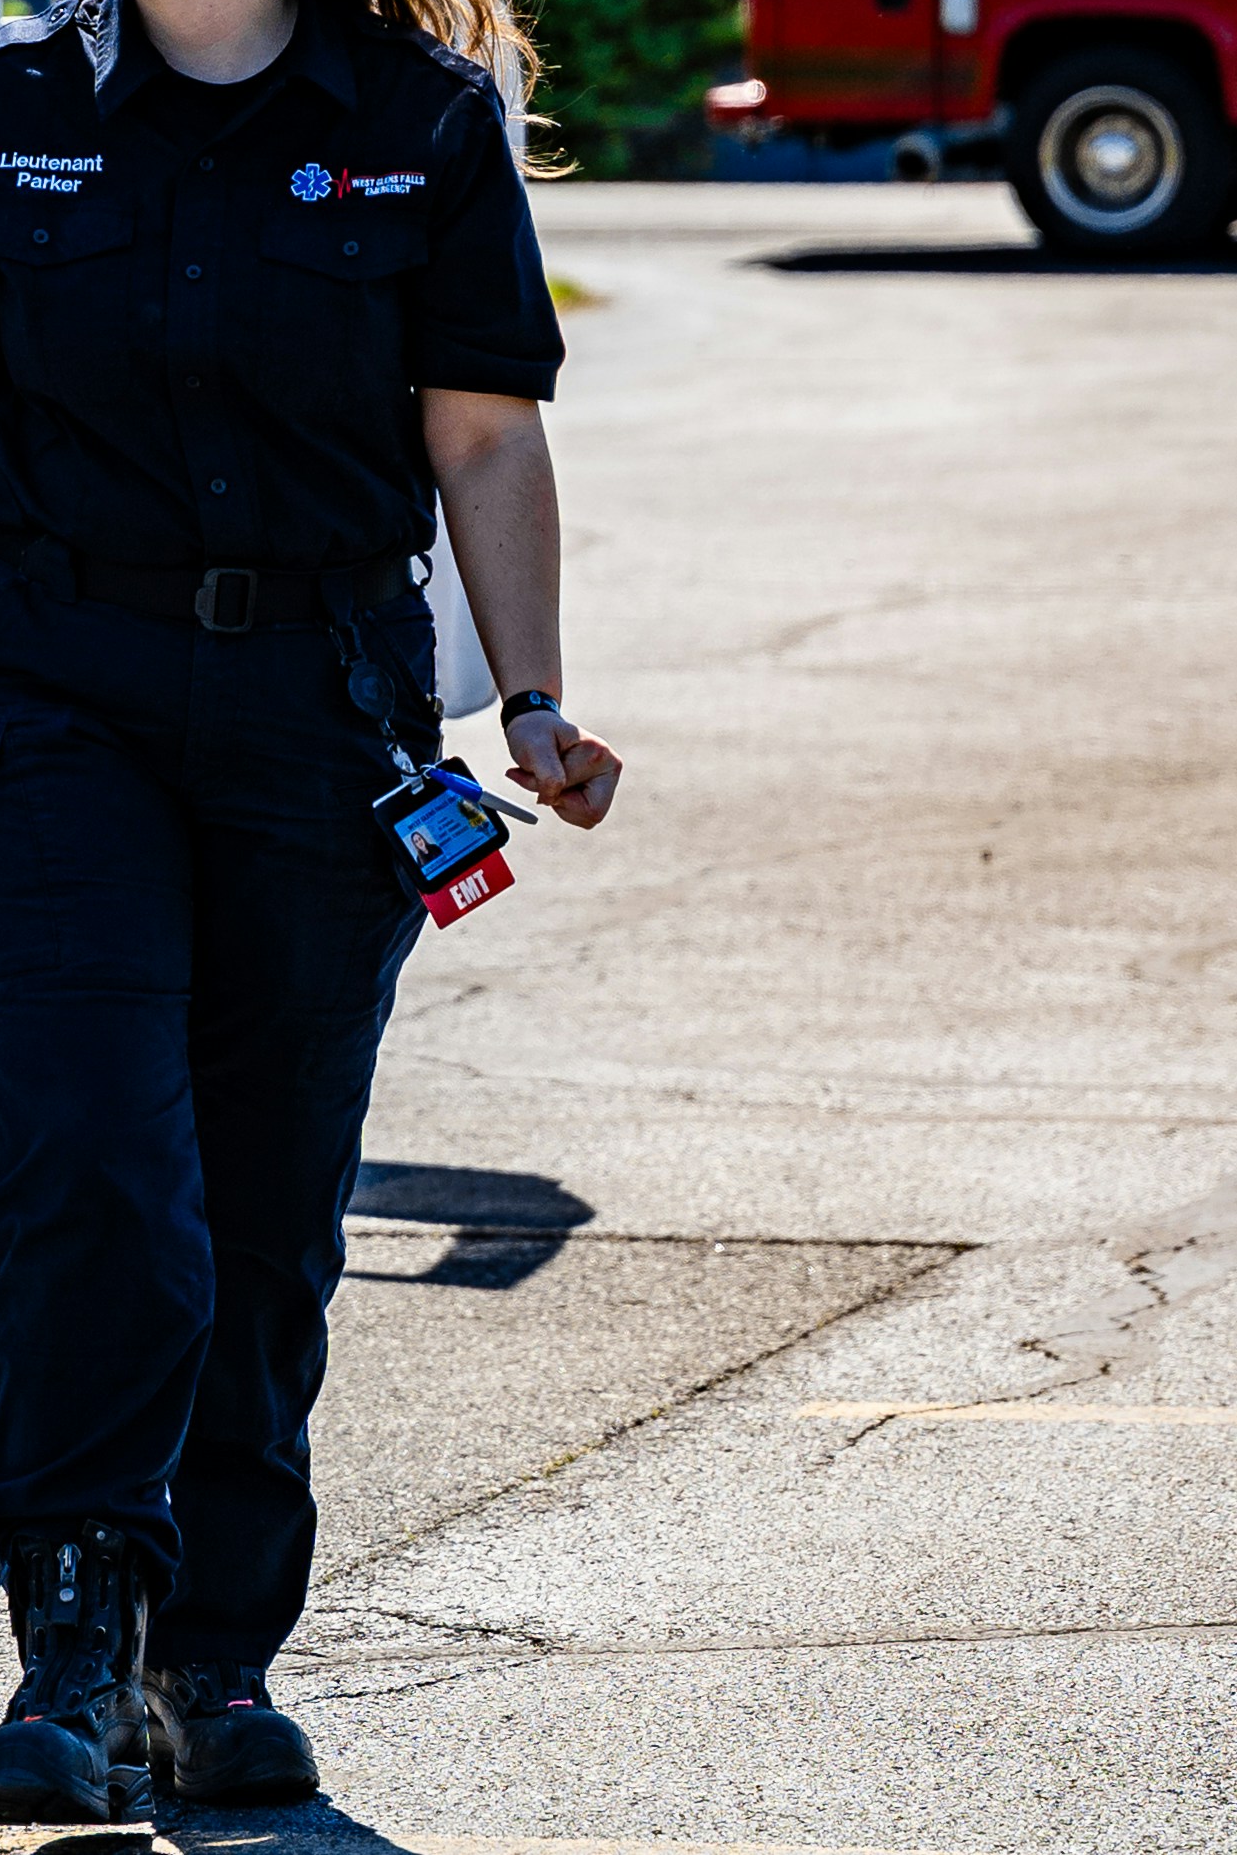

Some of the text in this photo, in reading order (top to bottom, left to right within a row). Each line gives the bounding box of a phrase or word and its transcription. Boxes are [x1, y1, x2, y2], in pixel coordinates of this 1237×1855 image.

[0, 151, 104, 172] Lieutenant
[16, 172, 82, 193] Parker
[351, 178, 375, 188] WEST
[400, 174, 426, 185] FALLS
[449, 868, 490, 910] EMT
